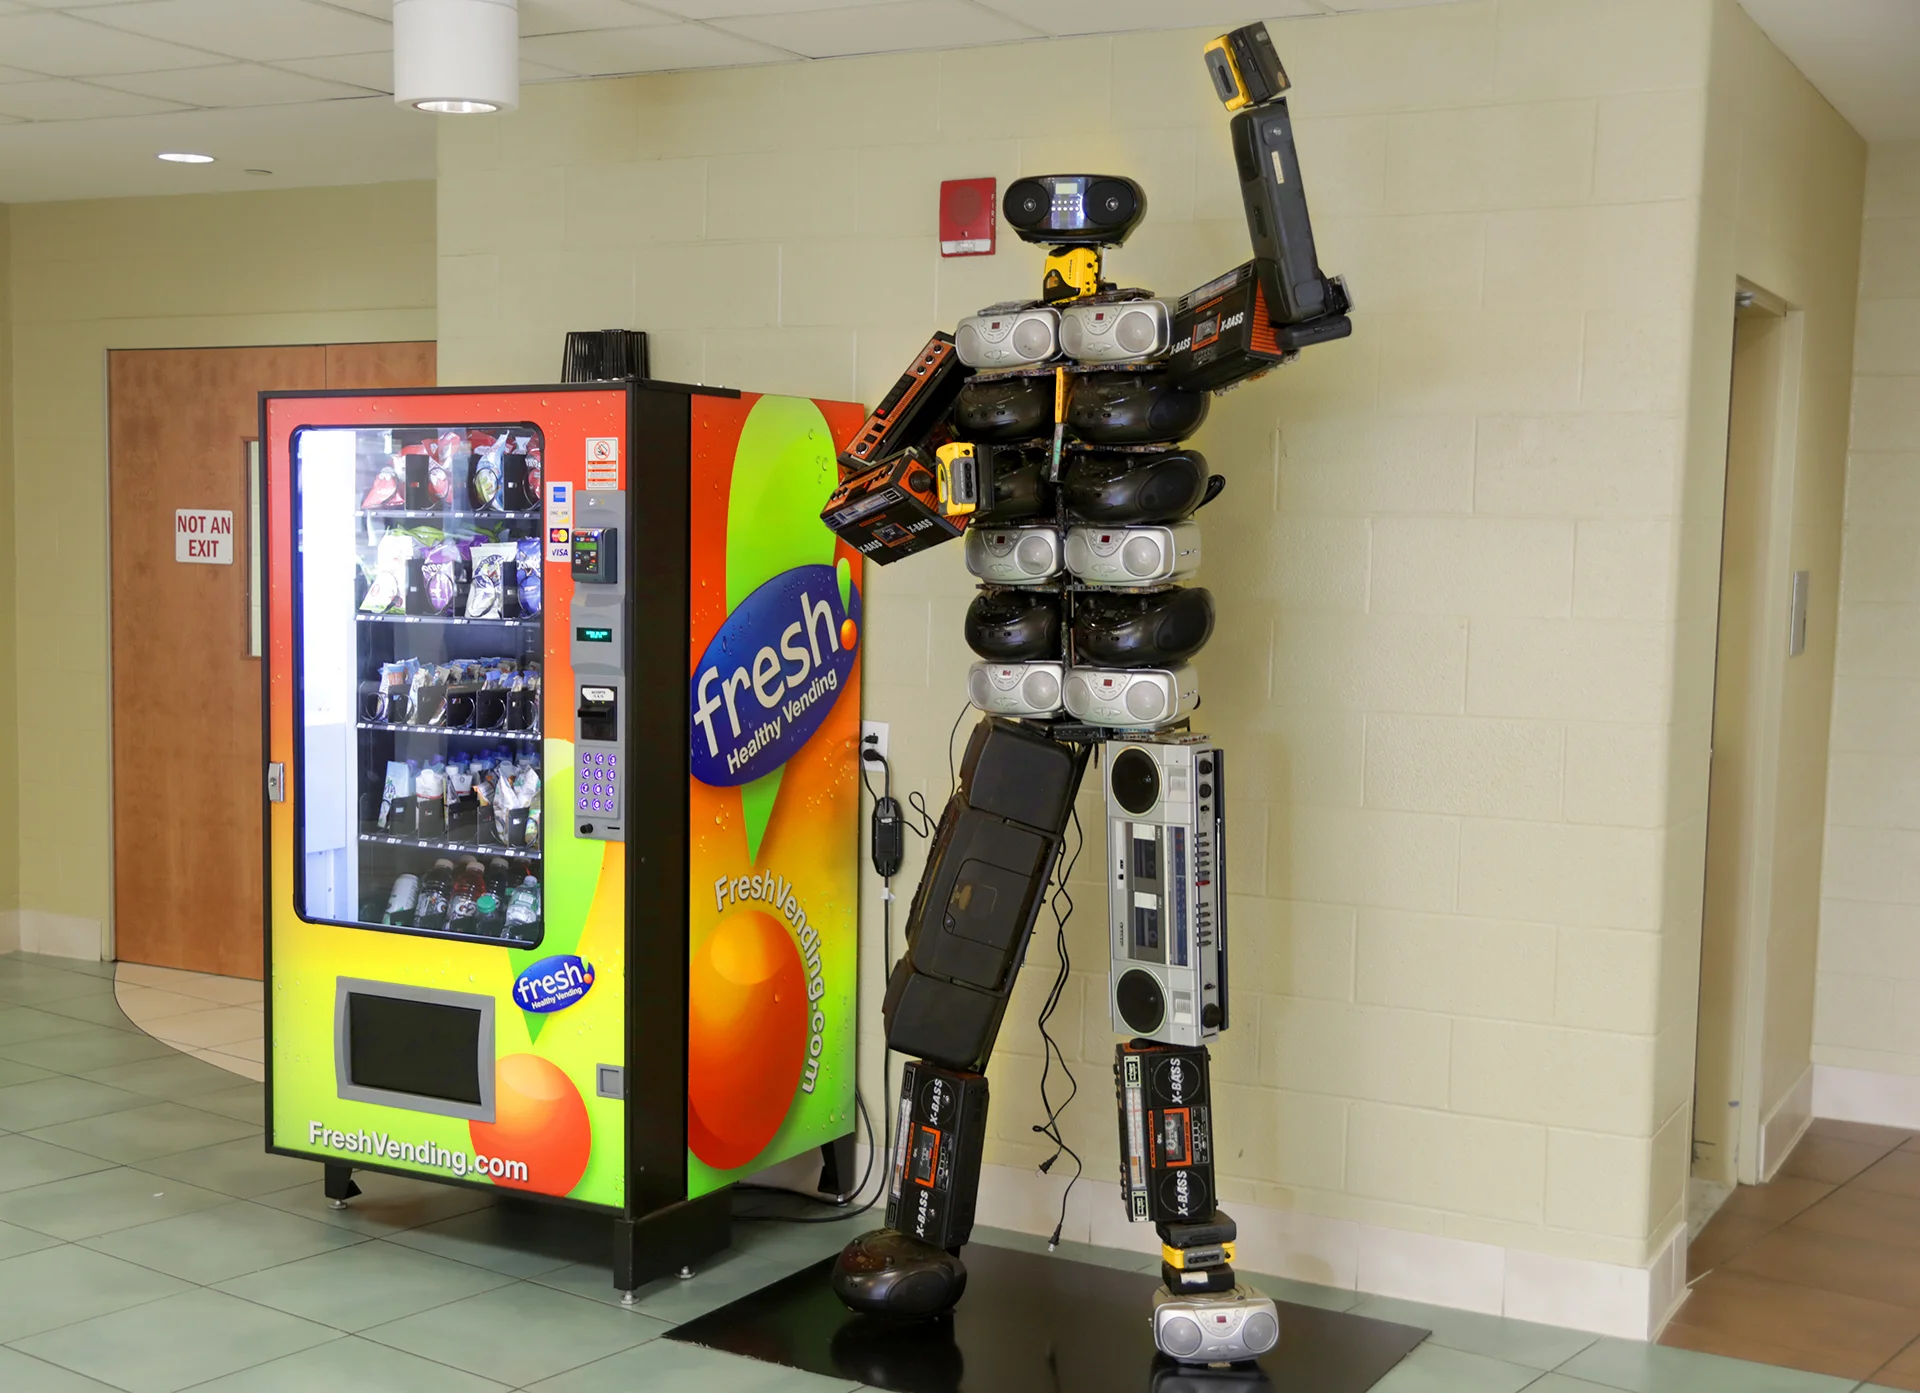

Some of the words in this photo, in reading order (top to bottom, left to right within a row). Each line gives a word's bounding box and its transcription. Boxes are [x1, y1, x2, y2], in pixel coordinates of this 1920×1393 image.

[1219, 311, 1244, 333] X-BASS
[1169, 336, 1191, 356] X-BASS
[178, 515, 206, 533] NOT
[210, 517, 231, 534] AN
[906, 517, 934, 534] X-BASS
[189, 539, 219, 557] EXIT
[551, 548, 568, 557] VISA
[726, 716, 782, 775] Healthy
[781, 668, 838, 724] Vending
[531, 996, 556, 1010] Healthy
[556, 986, 583, 1001] Vending
[713, 868, 825, 1094] FreshVending.com
[1170, 1057, 1183, 1105] X-BASS
[929, 1078, 943, 1126] X-BASS
[308, 1120, 528, 1182] FreshVending.com
[1177, 1169, 1189, 1217] X-BASS
[916, 1189, 929, 1238] X-BASS
